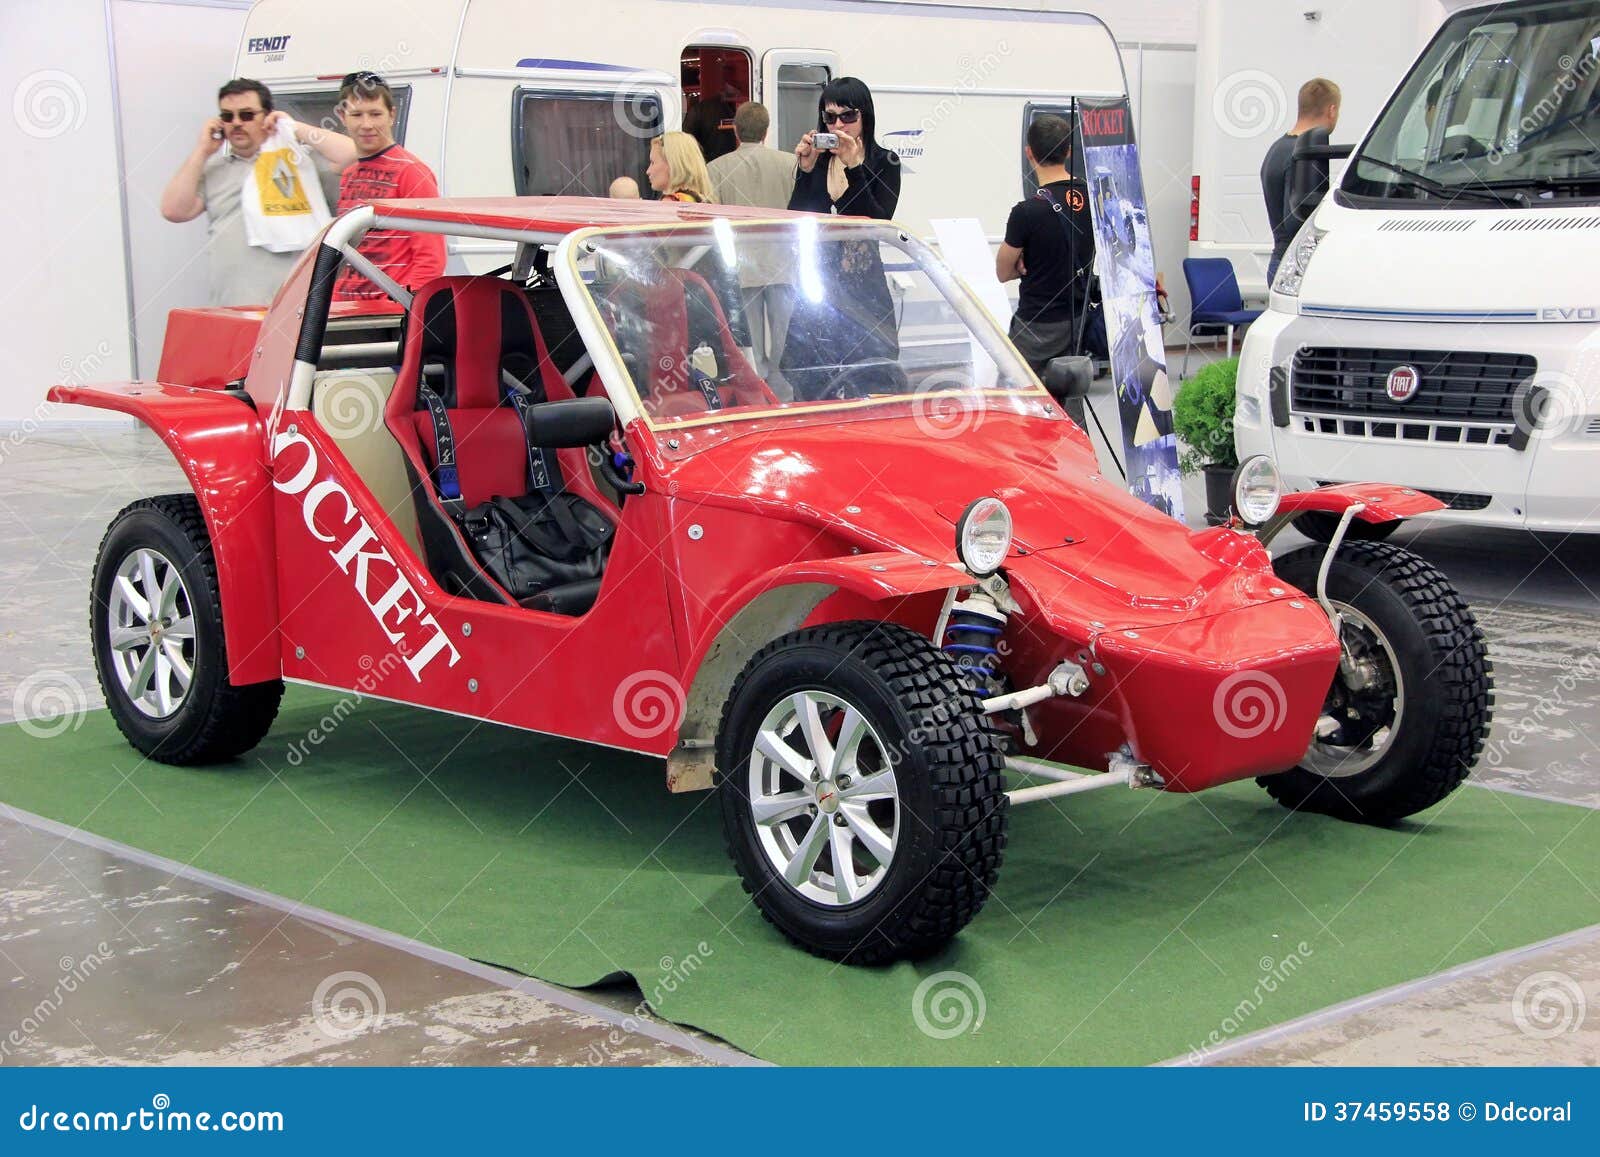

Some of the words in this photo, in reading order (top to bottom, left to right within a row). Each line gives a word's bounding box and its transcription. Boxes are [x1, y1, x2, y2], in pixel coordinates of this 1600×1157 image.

[248, 35, 291, 52] FENDT
[1082, 108, 1125, 136] ROCKET
[1542, 308, 1596, 320] EVO
[1392, 376, 1411, 392] FIAT
